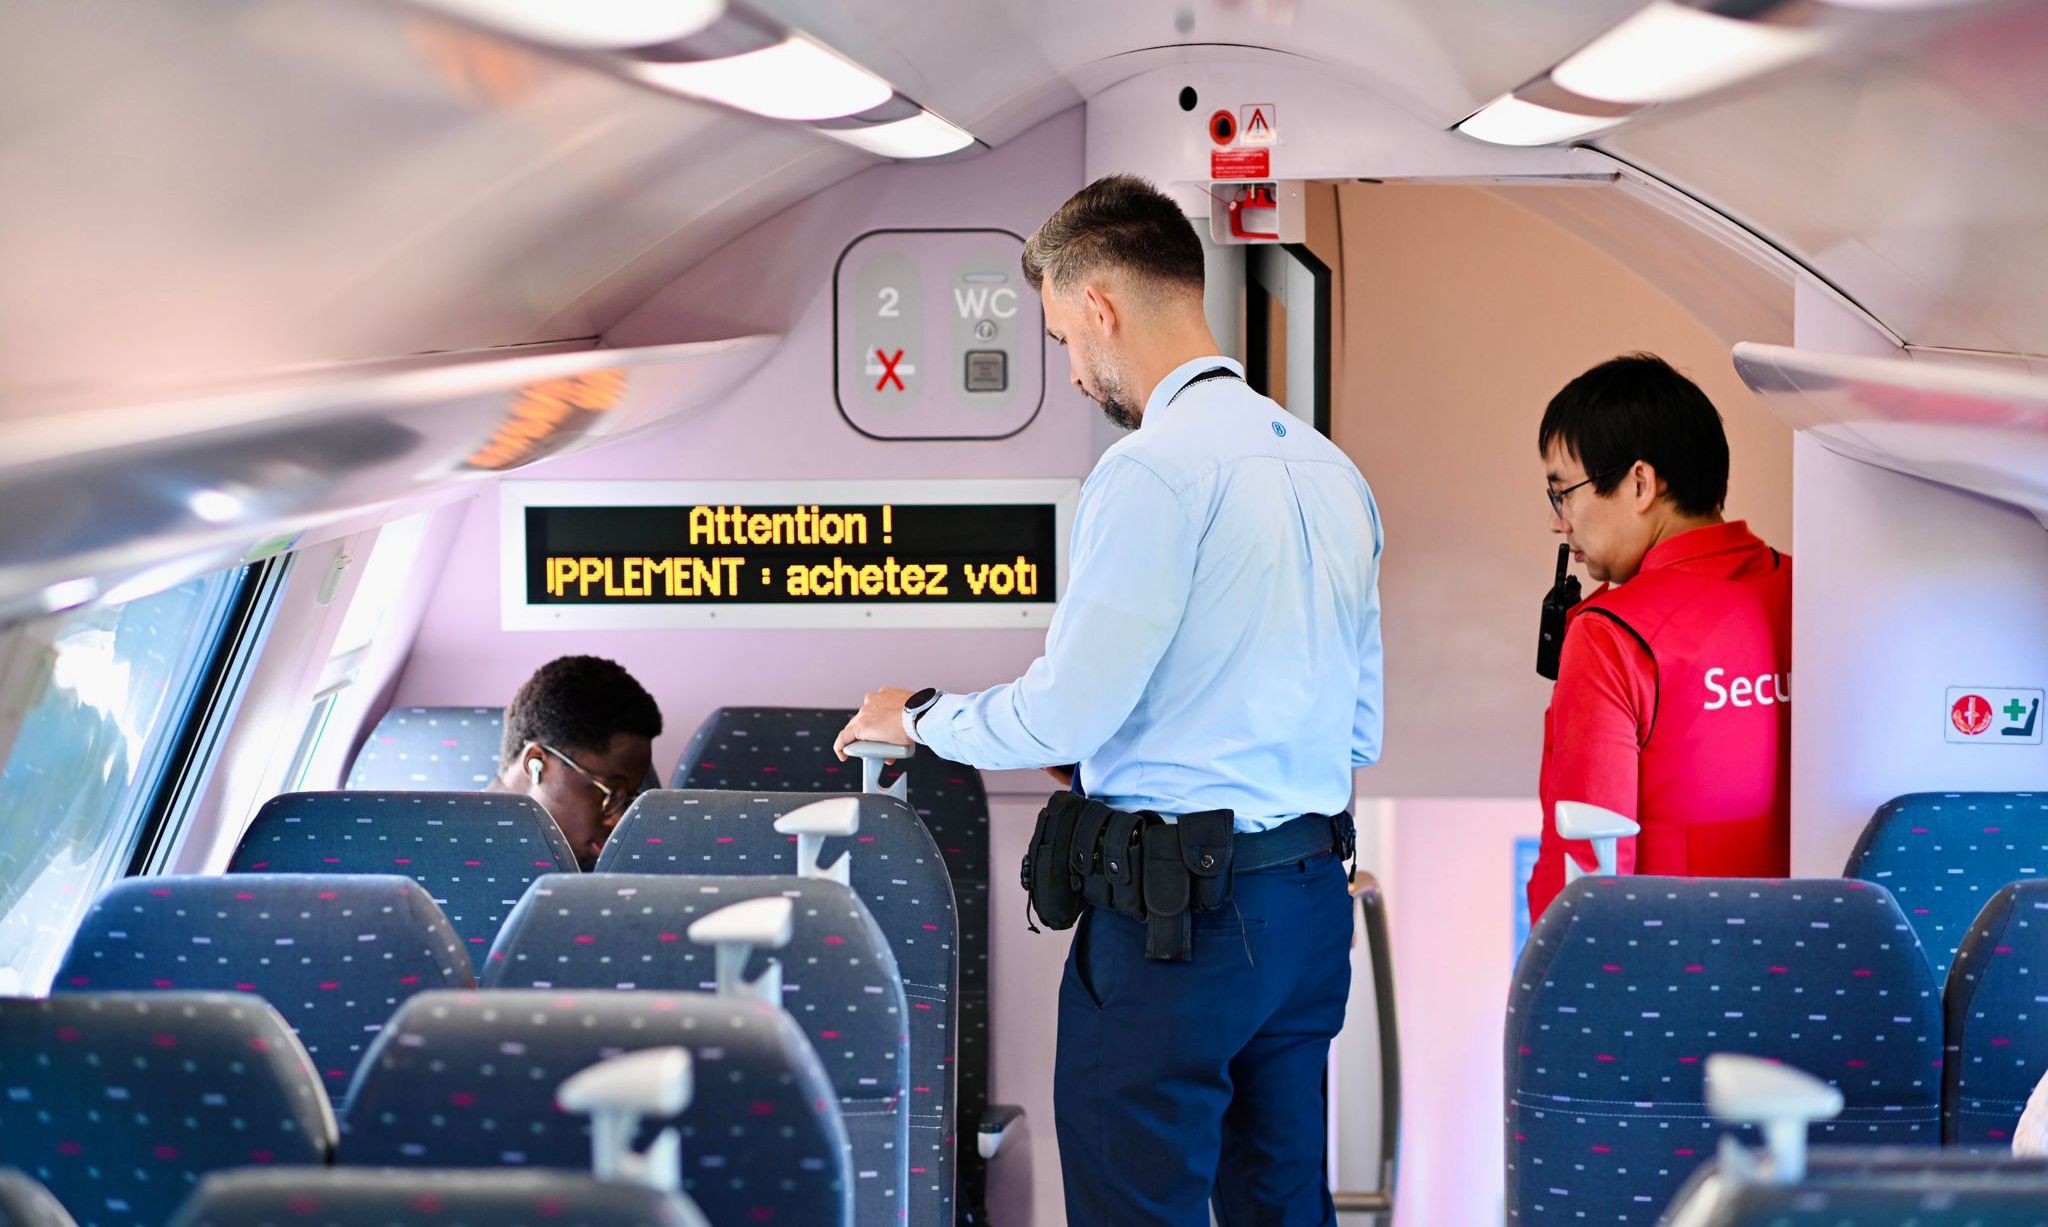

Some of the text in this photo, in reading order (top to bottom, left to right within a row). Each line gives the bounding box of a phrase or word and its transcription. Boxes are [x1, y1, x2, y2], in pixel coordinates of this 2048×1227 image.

[878, 286, 900, 318] 2
[953, 287, 1019, 319] WC
[689, 503, 892, 545] Attention !
[761, 567, 771, 585] :
[786, 555, 949, 596] achetez
[1703, 667, 1791, 710] Secu
